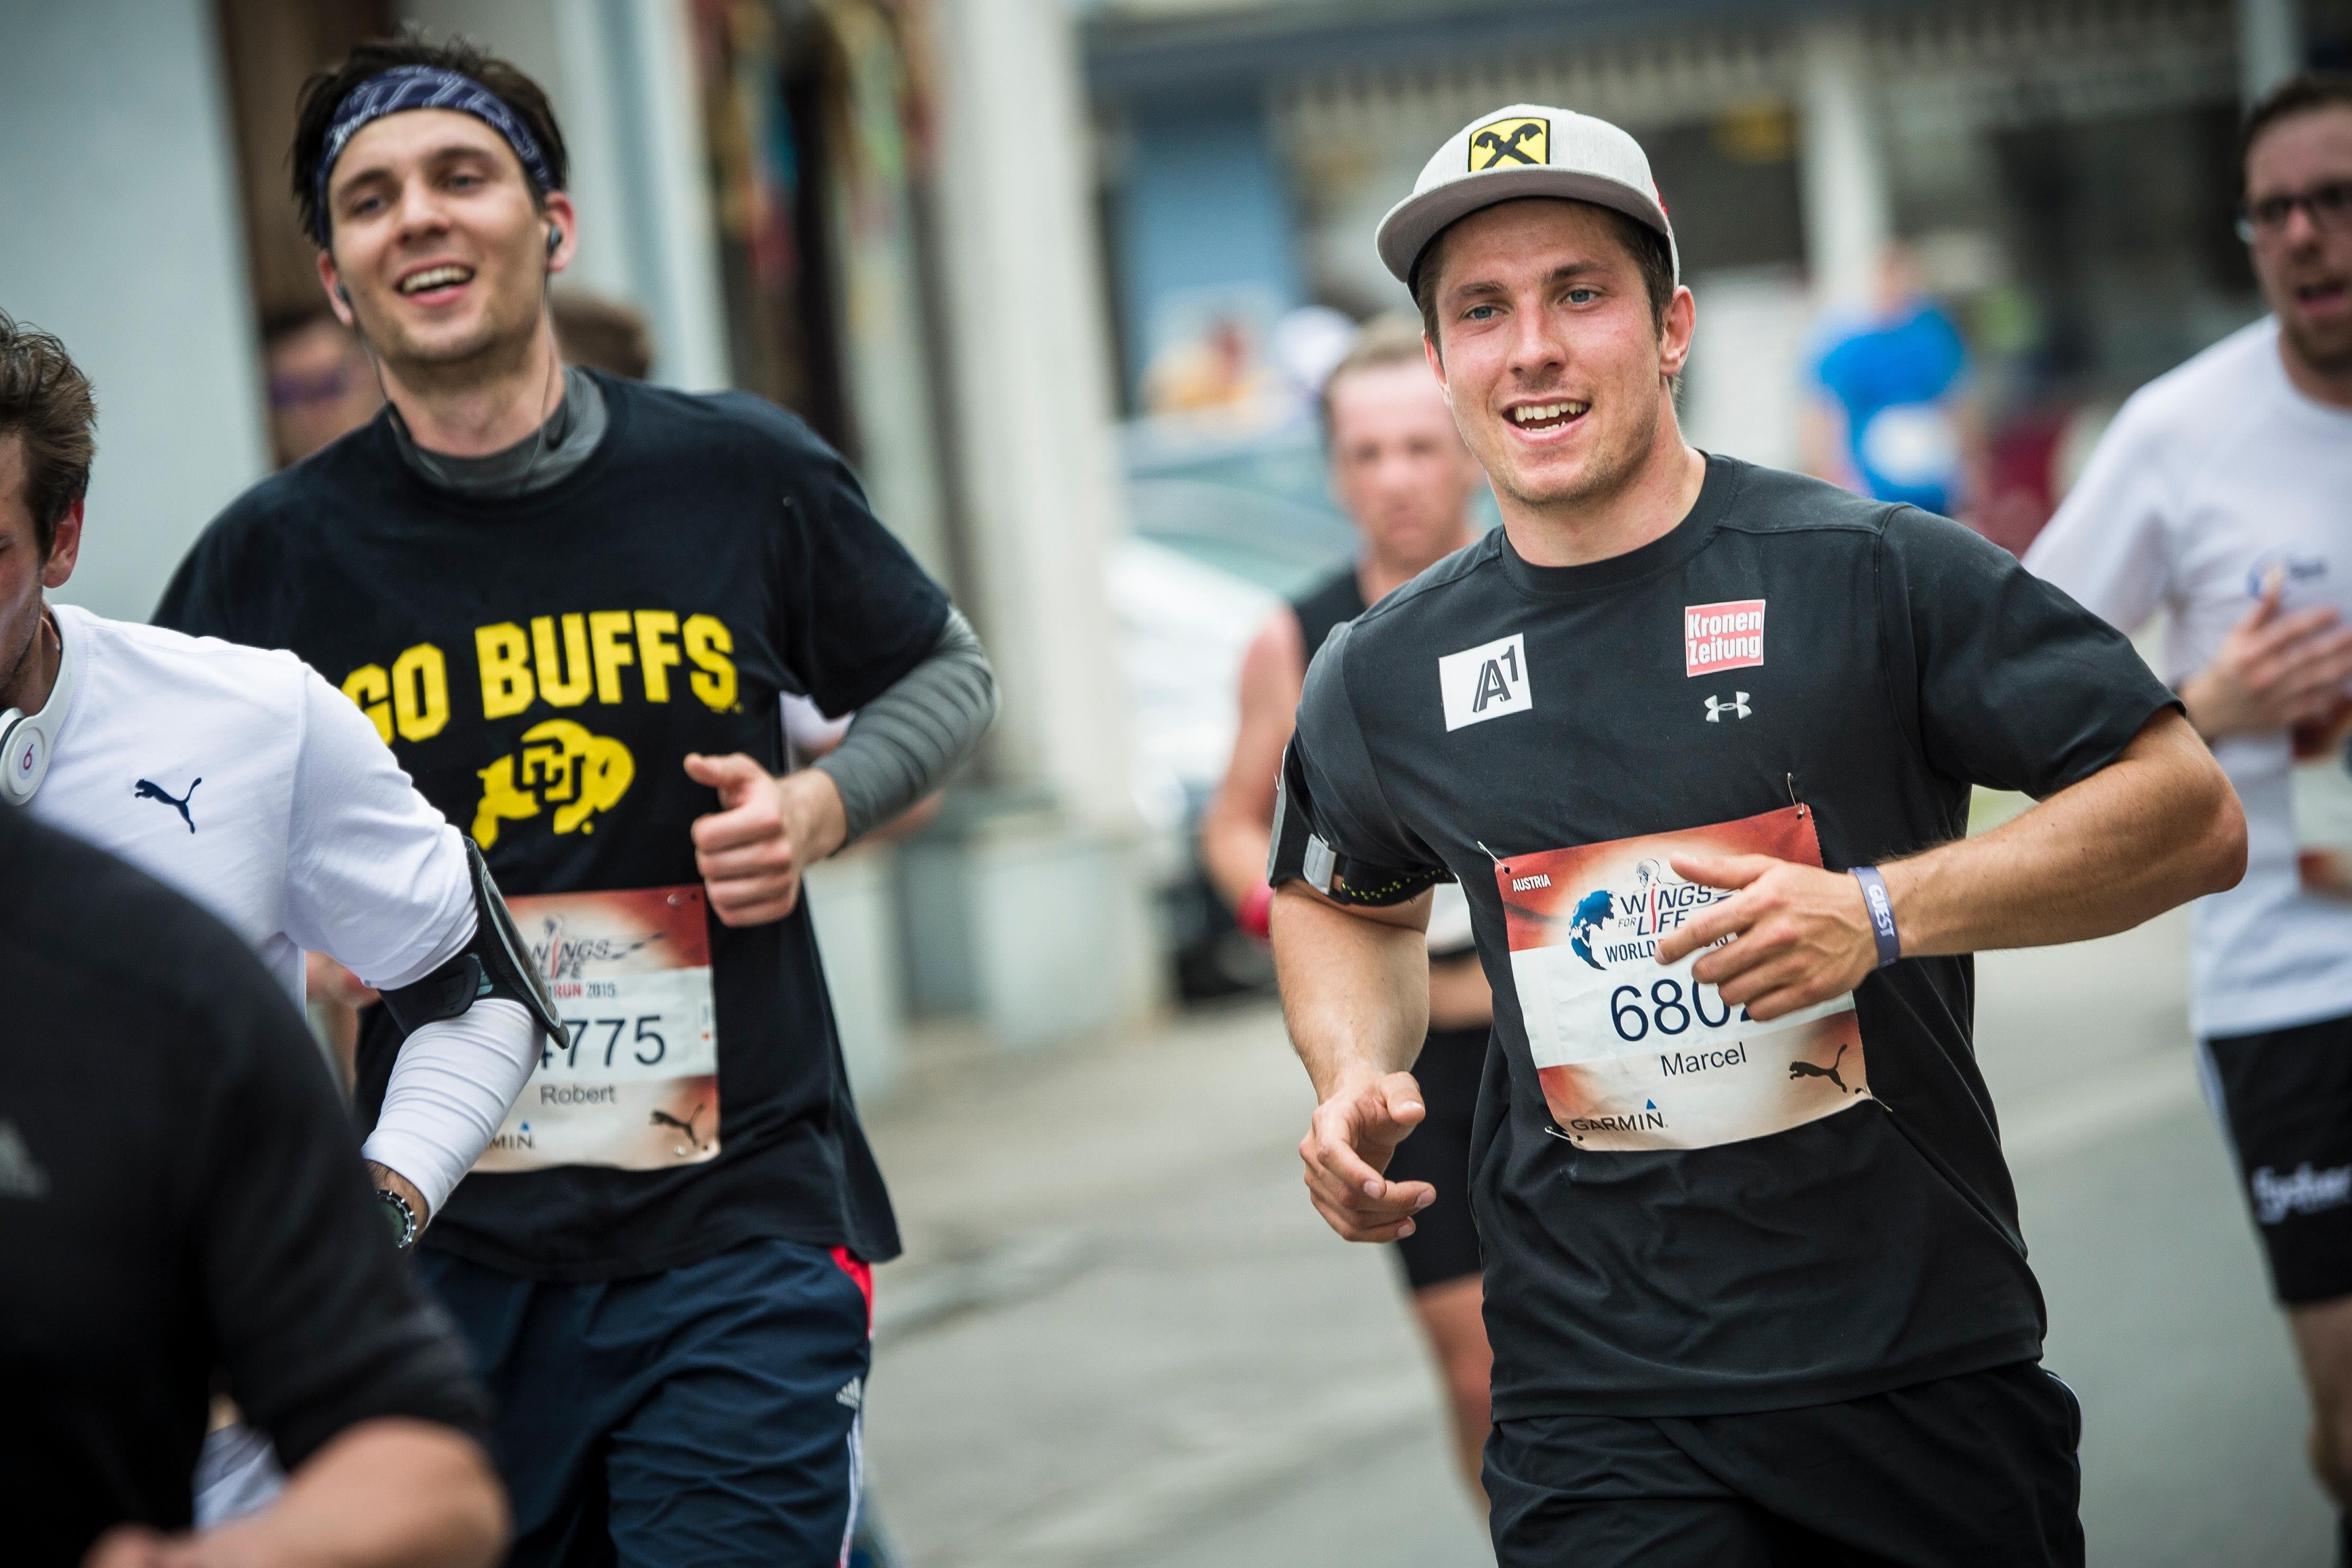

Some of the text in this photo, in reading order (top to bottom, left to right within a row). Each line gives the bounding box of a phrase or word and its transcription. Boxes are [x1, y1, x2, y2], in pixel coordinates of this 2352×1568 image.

[1688, 611, 1761, 639] Kronen
[1688, 636, 1761, 666] Zeitung
[340, 609, 737, 747] GO BUFFS
[1473, 644, 1519, 713] A1
[1512, 874, 1551, 892] AUSTRIA
[1620, 883, 1712, 915] WINGS
[1868, 884, 1895, 937] GUEST
[1618, 917, 1636, 928] FOR
[1605, 940, 1656, 963] WORLD
[554, 983, 582, 998] RUN
[585, 982, 616, 998] 2015
[1610, 979, 1752, 1042] 680
[541, 1014, 665, 1070] 775
[1660, 1041, 1747, 1076] Marcel
[541, 1083, 616, 1104] Robert
[1571, 1112, 1664, 1131] GARMIN
